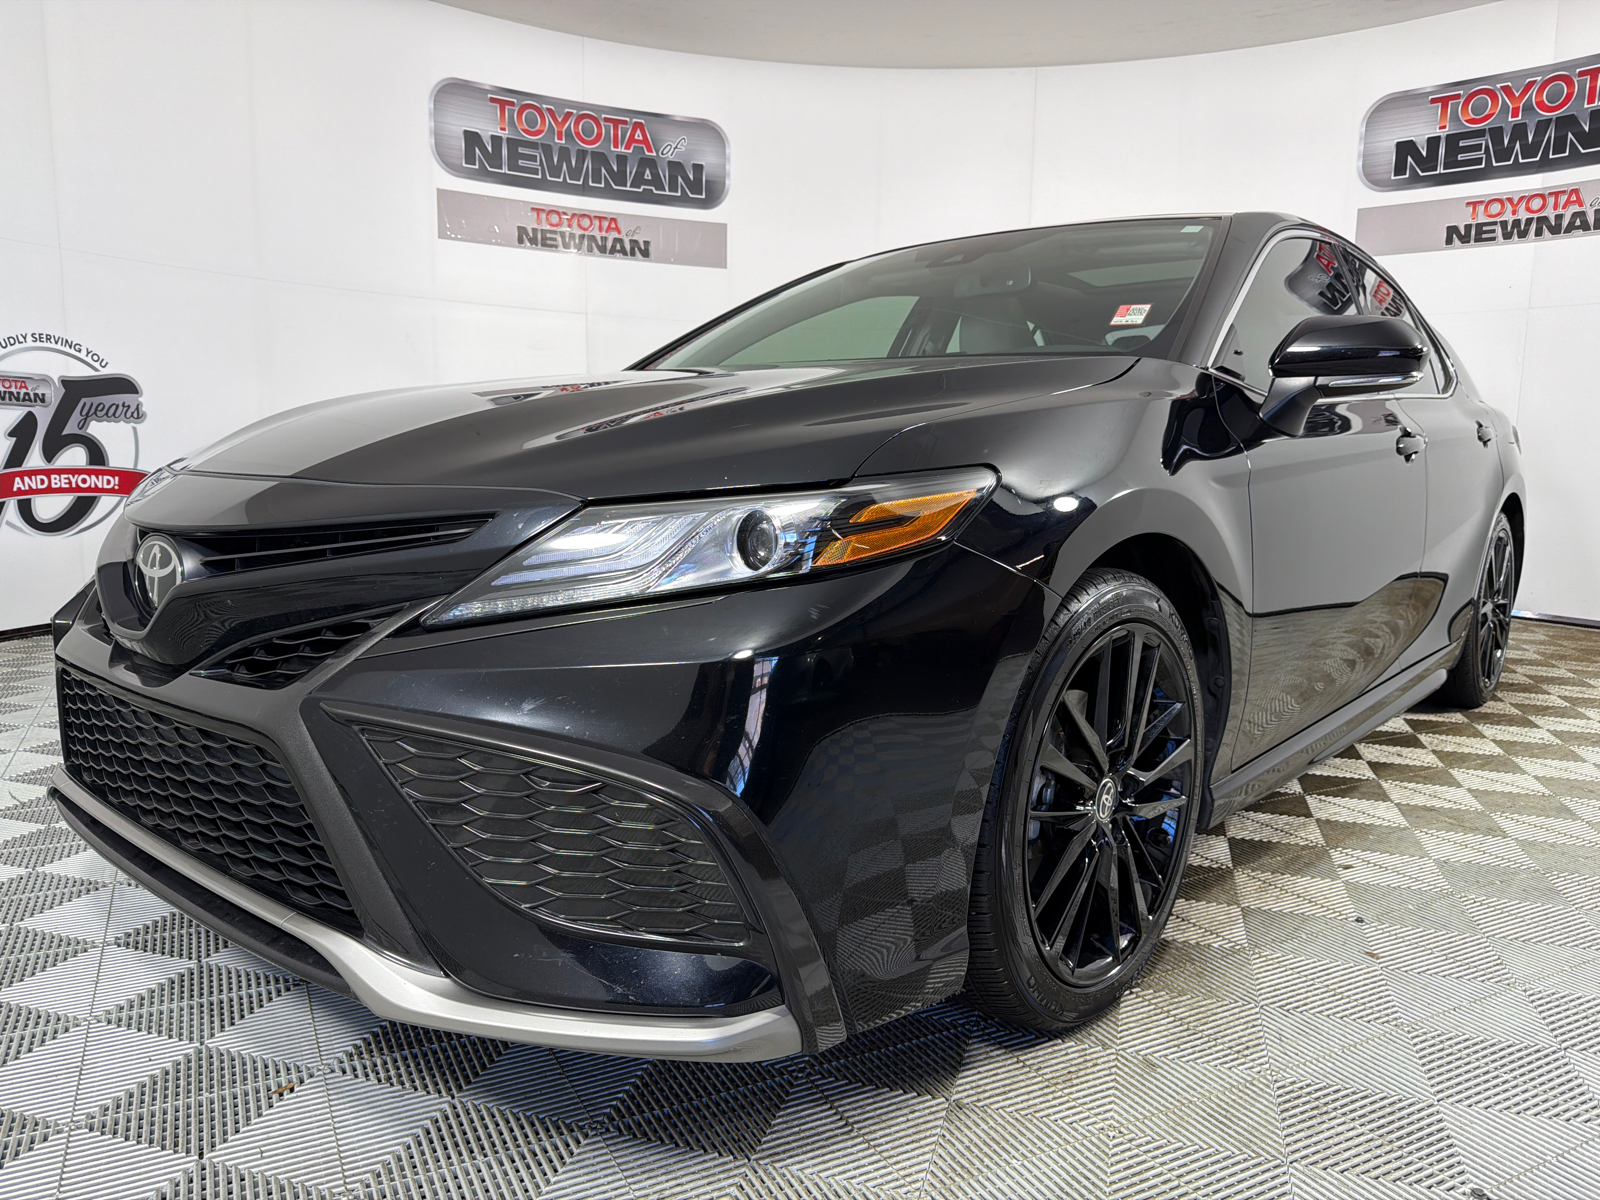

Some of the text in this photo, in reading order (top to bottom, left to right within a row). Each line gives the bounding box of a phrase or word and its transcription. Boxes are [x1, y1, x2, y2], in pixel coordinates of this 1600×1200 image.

[1429, 65, 1600, 131] TOYOT
[488, 96, 687, 157] TOYOTA of
[1391, 108, 1600, 180] NEWN
[462, 128, 705, 198] NEWNAN
[530, 206, 622, 235] TOYOTA
[1465, 187, 1600, 221] TOYOTA o
[516, 225, 651, 259] NEWNAN
[1444, 208, 1600, 246] NEWNA
[0, 333, 109, 369] UDLY SERVING YOU
[0, 378, 29, 391] OTA
[0, 390, 46, 404] NAN
[77, 400, 145, 430] years
[13, 474, 119, 491] AND BEYOND!
